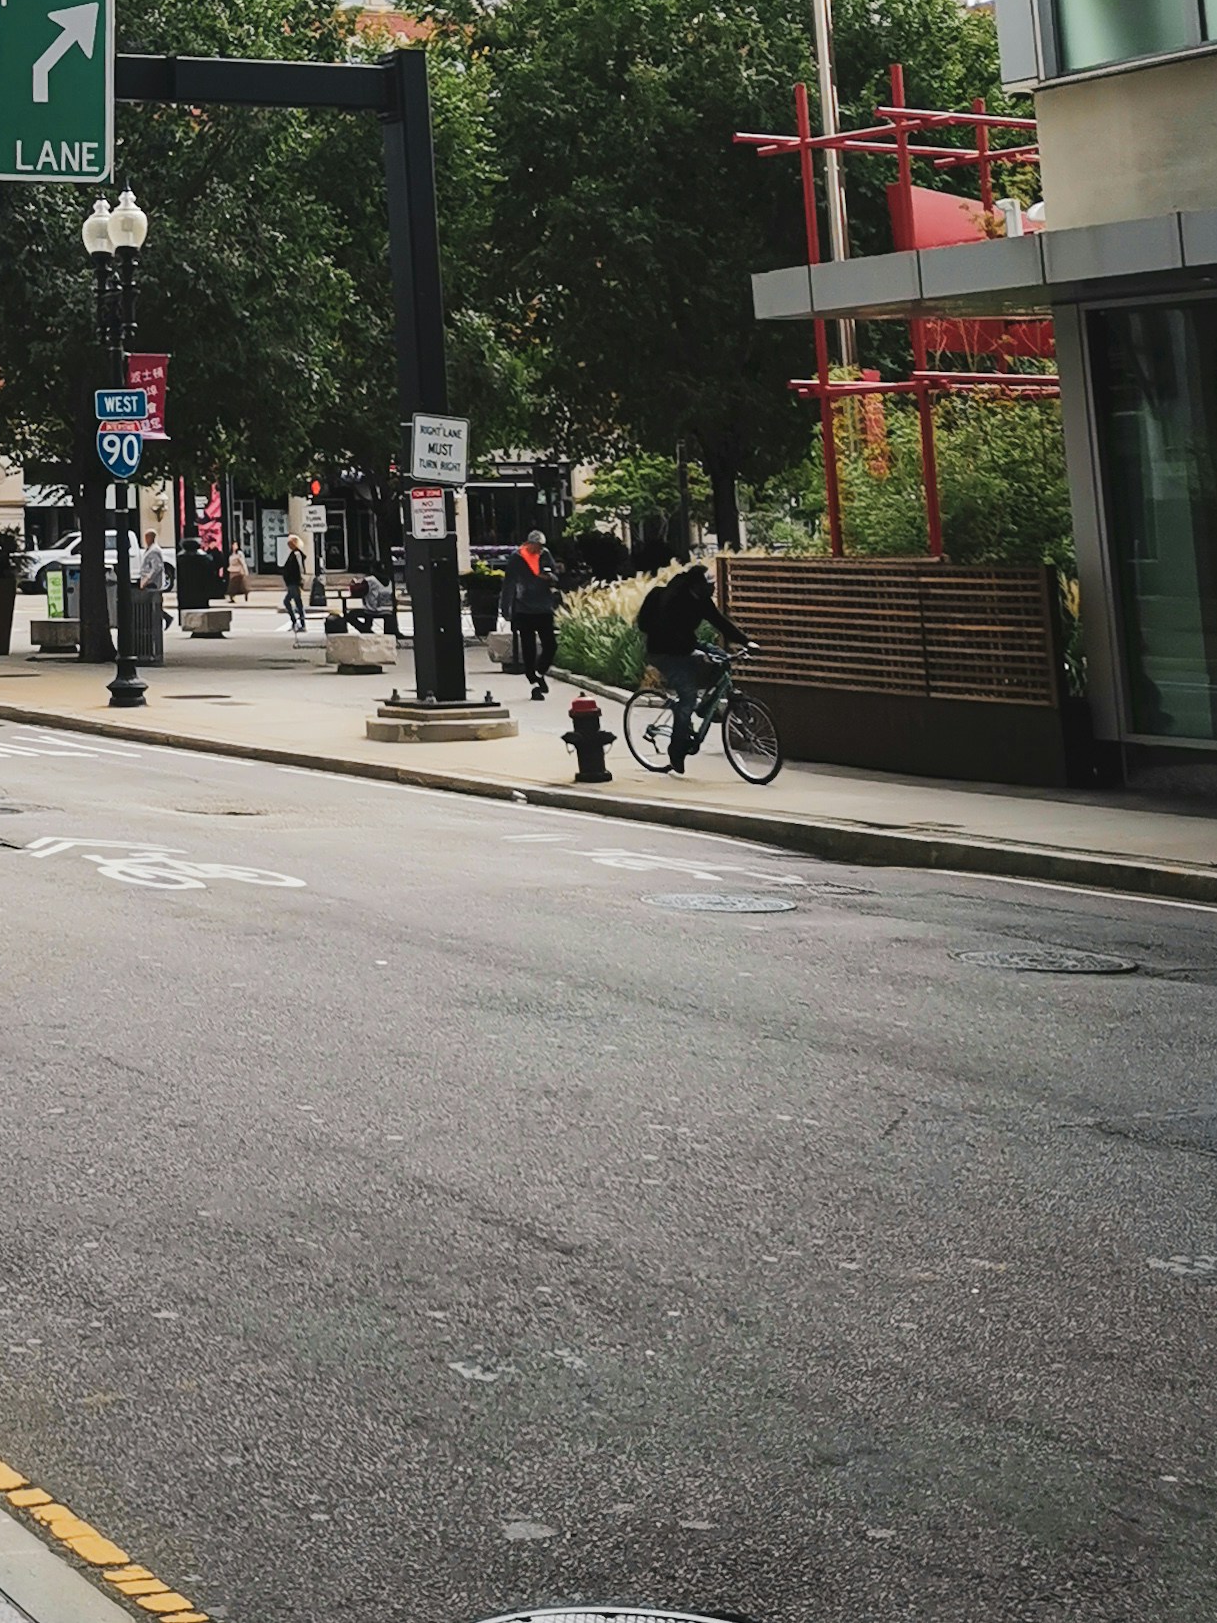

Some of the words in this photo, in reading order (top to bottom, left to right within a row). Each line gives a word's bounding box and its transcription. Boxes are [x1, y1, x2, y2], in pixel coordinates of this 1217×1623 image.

[16, 140, 100, 172] LANE
[104, 395, 138, 413] WEST
[420, 425, 440, 436] RIGHT
[443, 428, 463, 439] LANE
[102, 434, 139, 466] 90
[428, 443, 453, 456] MUST
[419, 458, 437, 469] TURN
[440, 461, 461, 472] RIGHT
